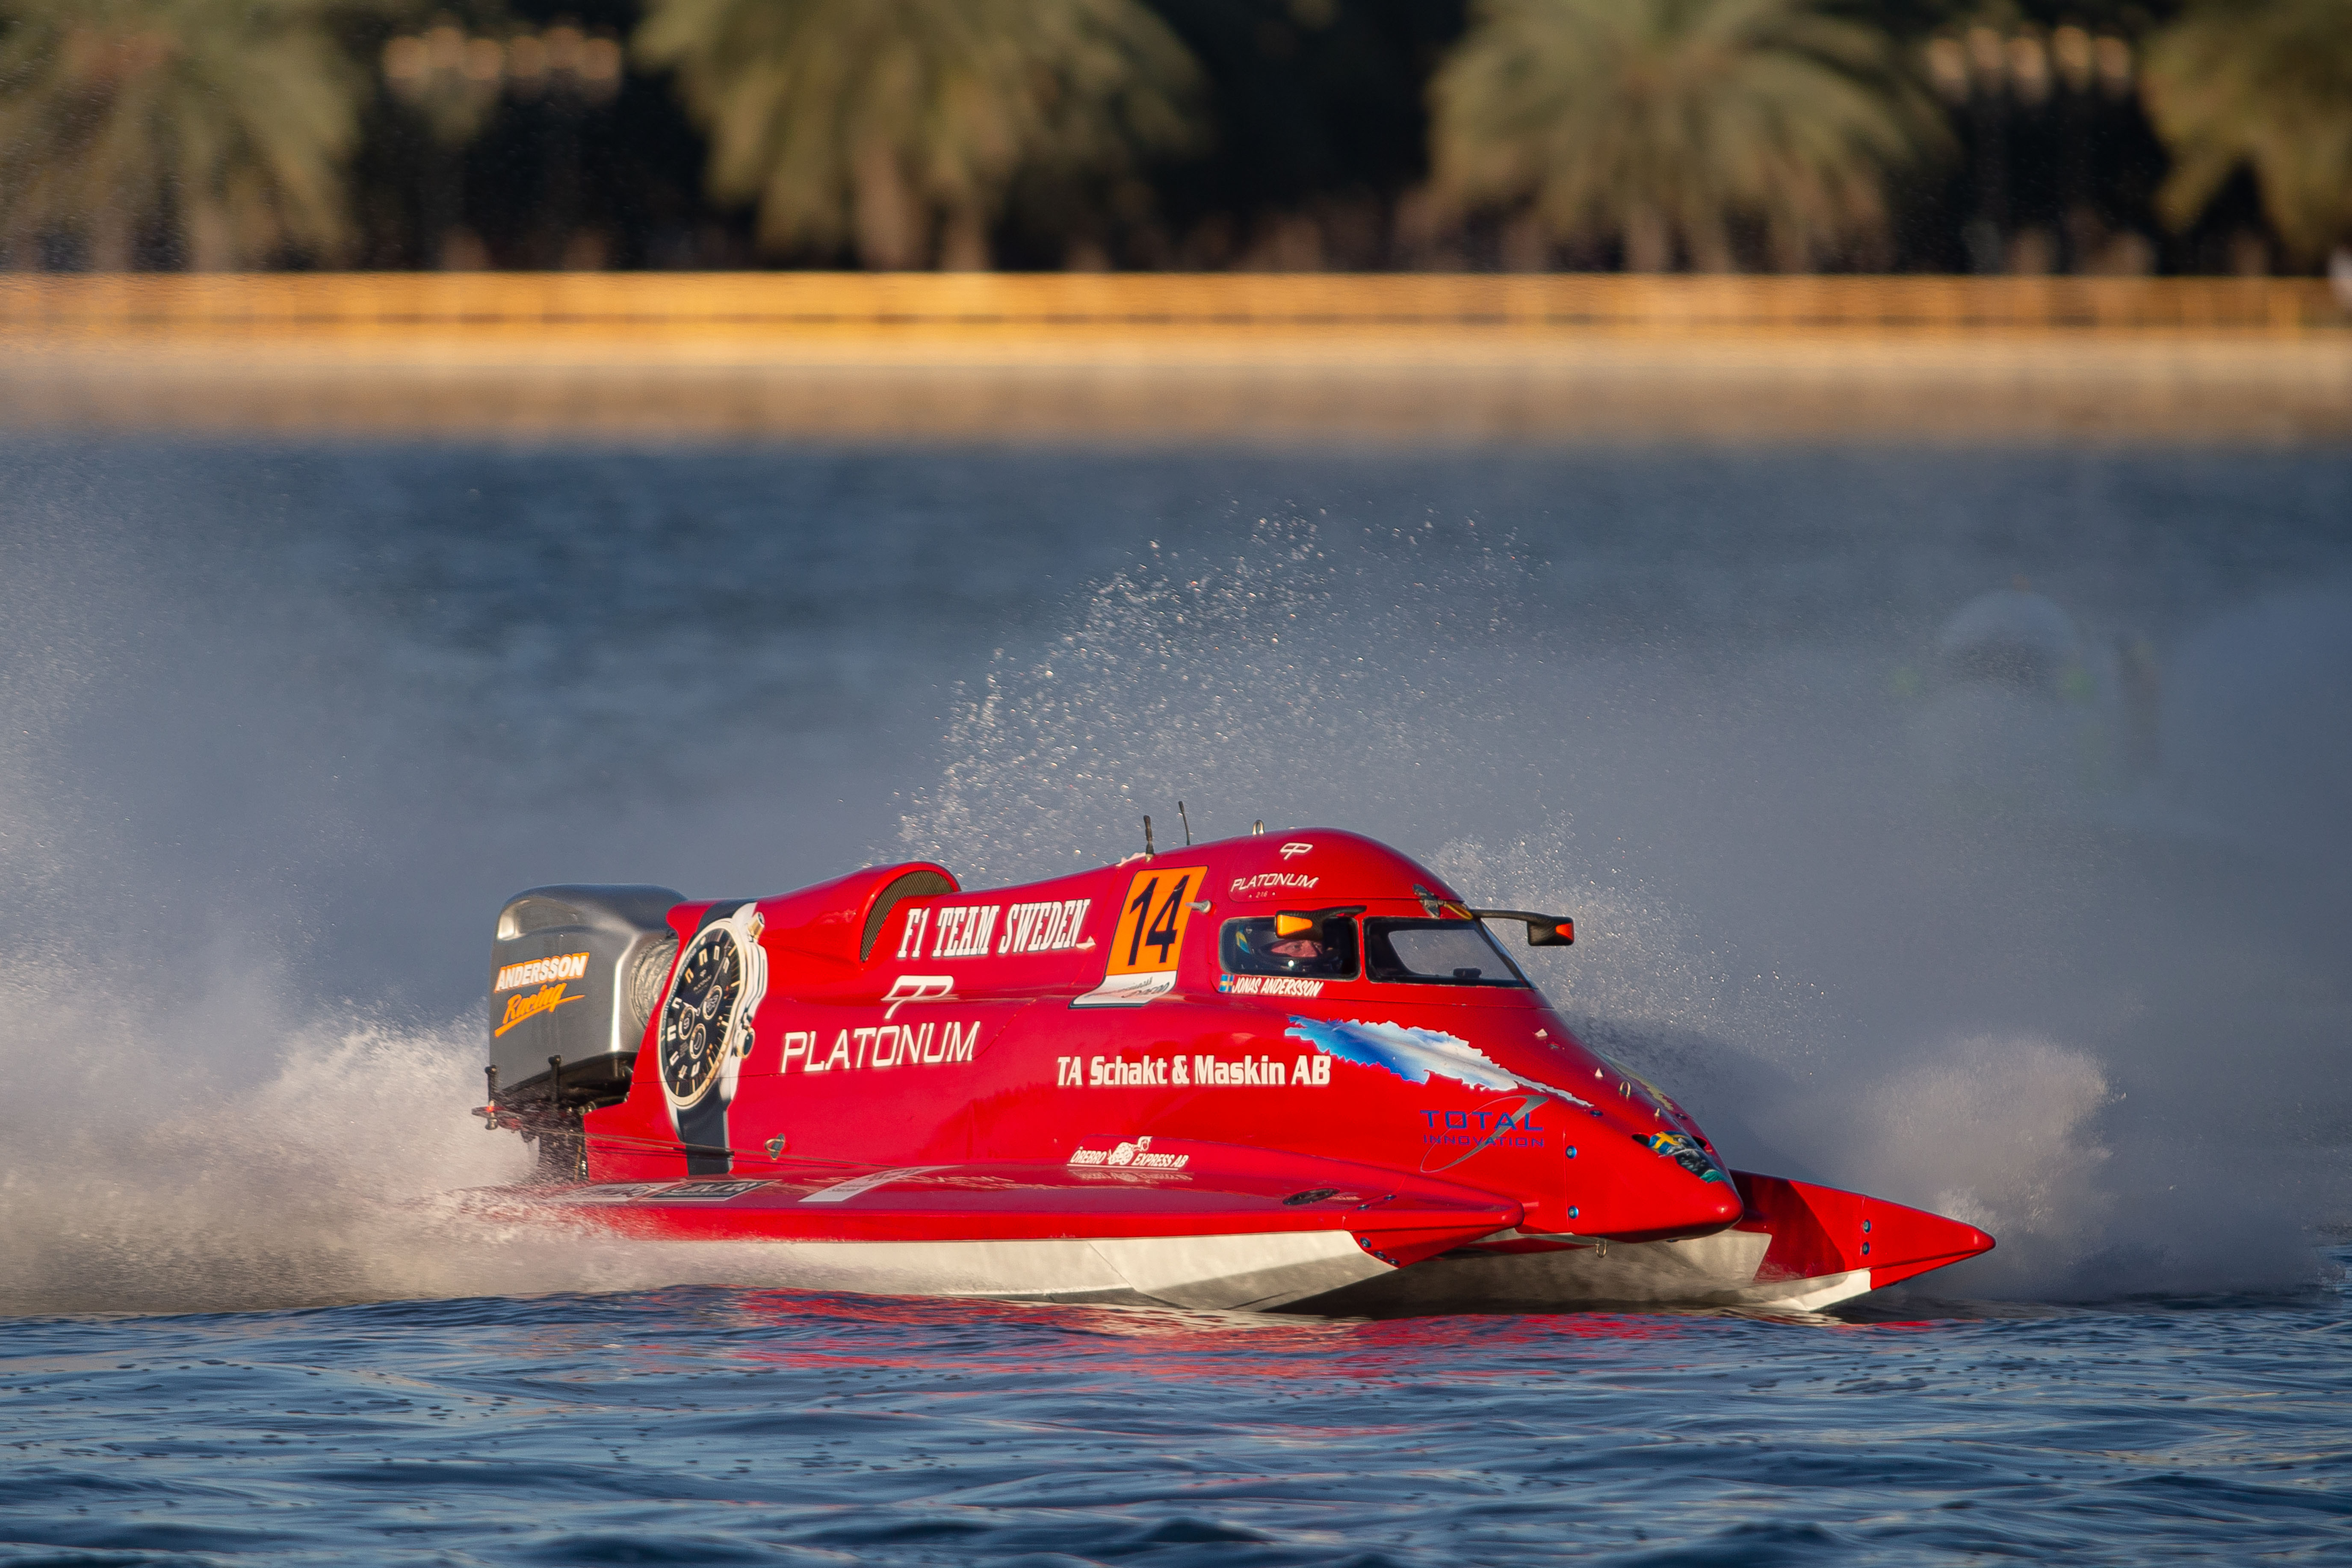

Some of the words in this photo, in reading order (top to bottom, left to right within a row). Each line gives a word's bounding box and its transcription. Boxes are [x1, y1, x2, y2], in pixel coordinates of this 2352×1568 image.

[1230, 873, 1319, 892] PLATONUM
[898, 907, 930, 958] F1
[932, 905, 1000, 957] TEAM
[998, 899, 1091, 954] SWEDEN
[1128, 875, 1190, 966] 14
[494, 952, 589, 993] ANDERSSON
[1232, 977, 1262, 993] JONAS
[1261, 977, 1324, 997] ANDERSSON
[502, 983, 567, 1024] Racing
[781, 1021, 981, 1074] PLATONUM
[1058, 1057, 1083, 1086] TA
[1090, 1055, 1167, 1085] Schakt
[1171, 1055, 1190, 1084] &
[1195, 1055, 1285, 1085] Maskin
[1291, 1055, 1332, 1085] AB
[1420, 1110, 1543, 1131] TOTAL
[1424, 1134, 1544, 1147] INNOVATION
[1070, 1146, 1107, 1164] ÖREBRO
[1131, 1153, 1175, 1167] EXPRESS
[1170, 1155, 1189, 1168] AB
